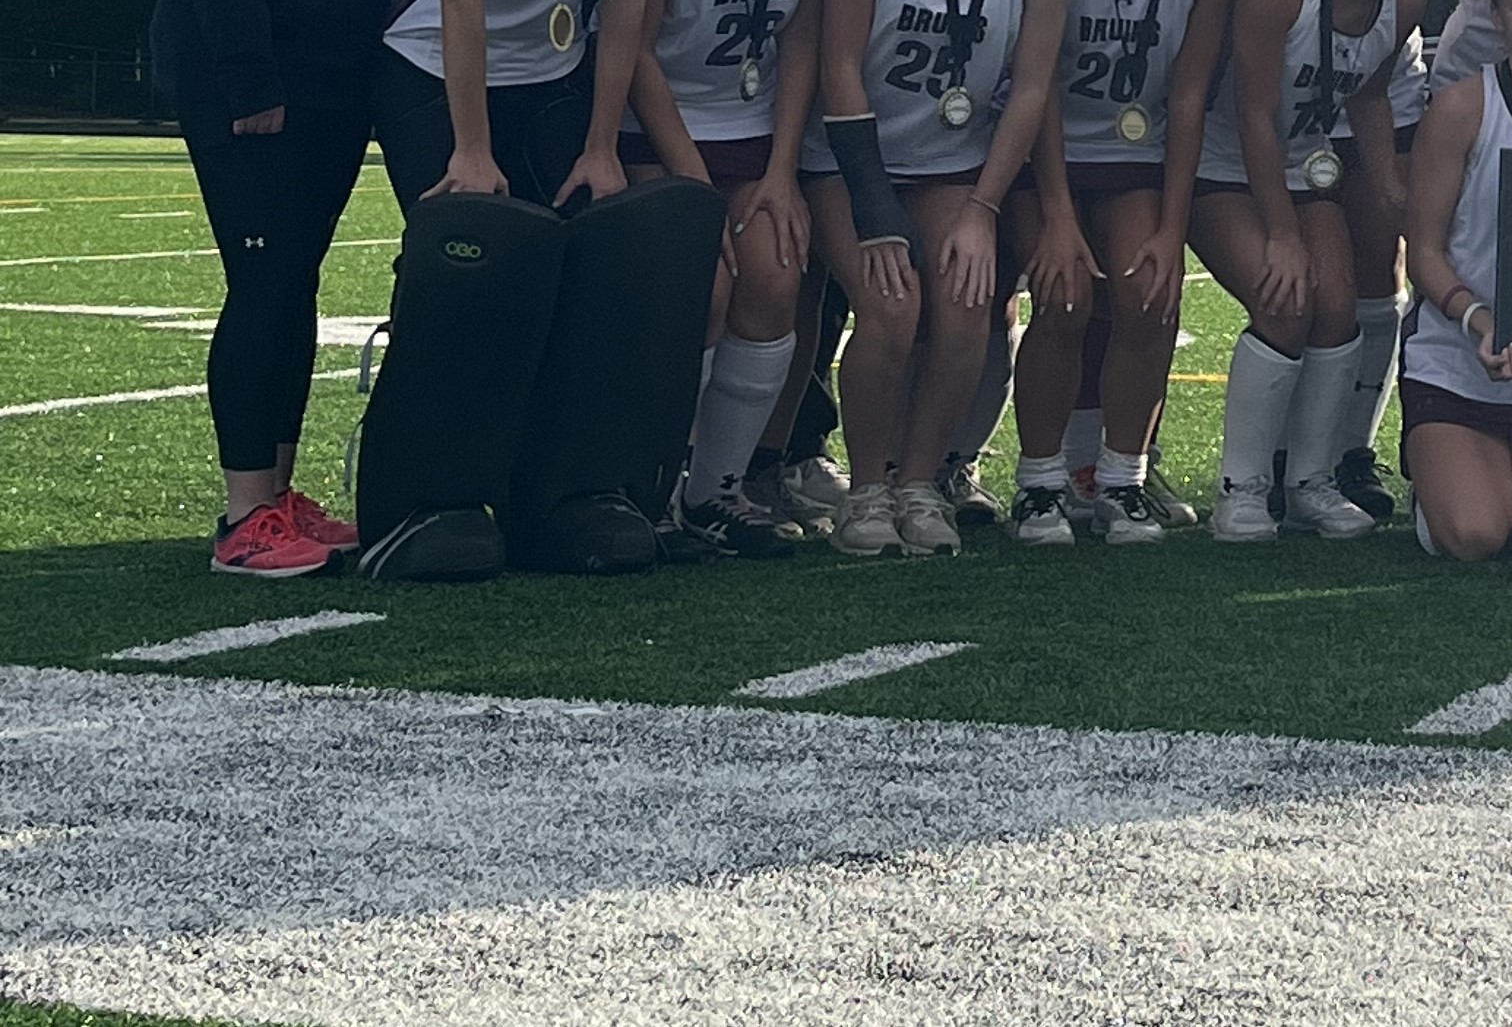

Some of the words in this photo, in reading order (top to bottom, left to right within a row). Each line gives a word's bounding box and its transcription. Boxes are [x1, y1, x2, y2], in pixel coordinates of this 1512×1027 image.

[896, 3, 988, 44] BRUS
[1079, 16, 1161, 47] BRUIS
[885, 40, 967, 101] 25
